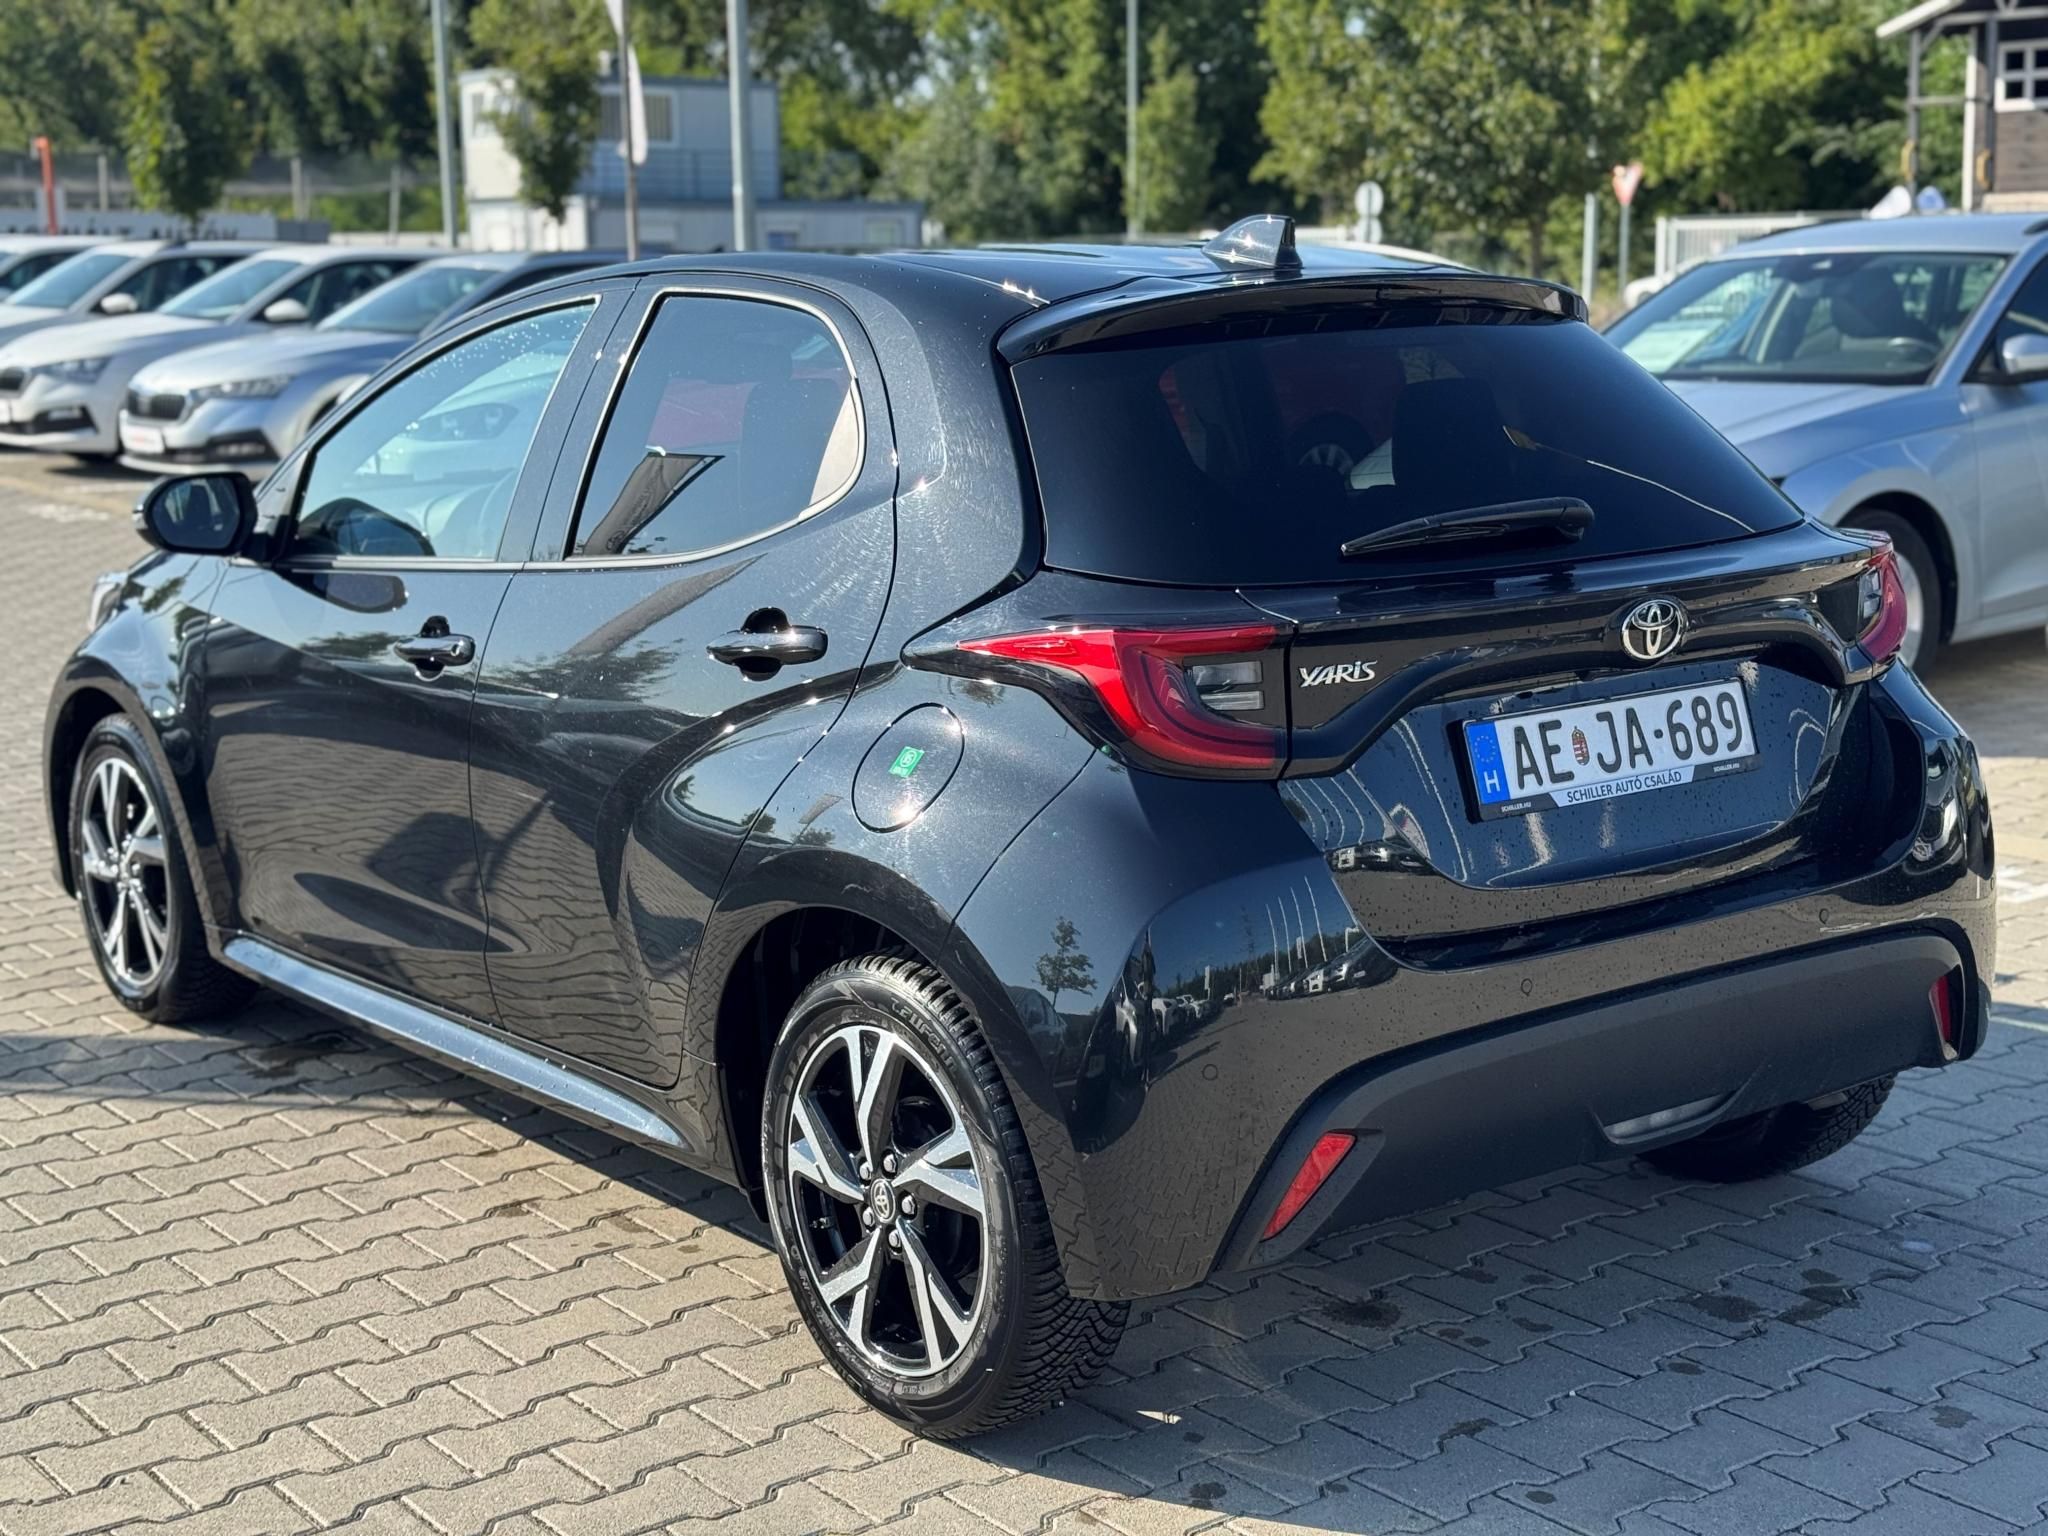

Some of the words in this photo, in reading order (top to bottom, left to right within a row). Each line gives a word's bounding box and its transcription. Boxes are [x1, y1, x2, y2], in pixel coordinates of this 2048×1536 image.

[1299, 660, 1378, 688] YARIS
[1513, 719, 1575, 790] AE
[1483, 769, 1501, 794] H
[1566, 784, 1614, 803] SCHILLER
[1615, 775, 1643, 794] AUTÓ
[1644, 768, 1682, 788] CSALÁD
